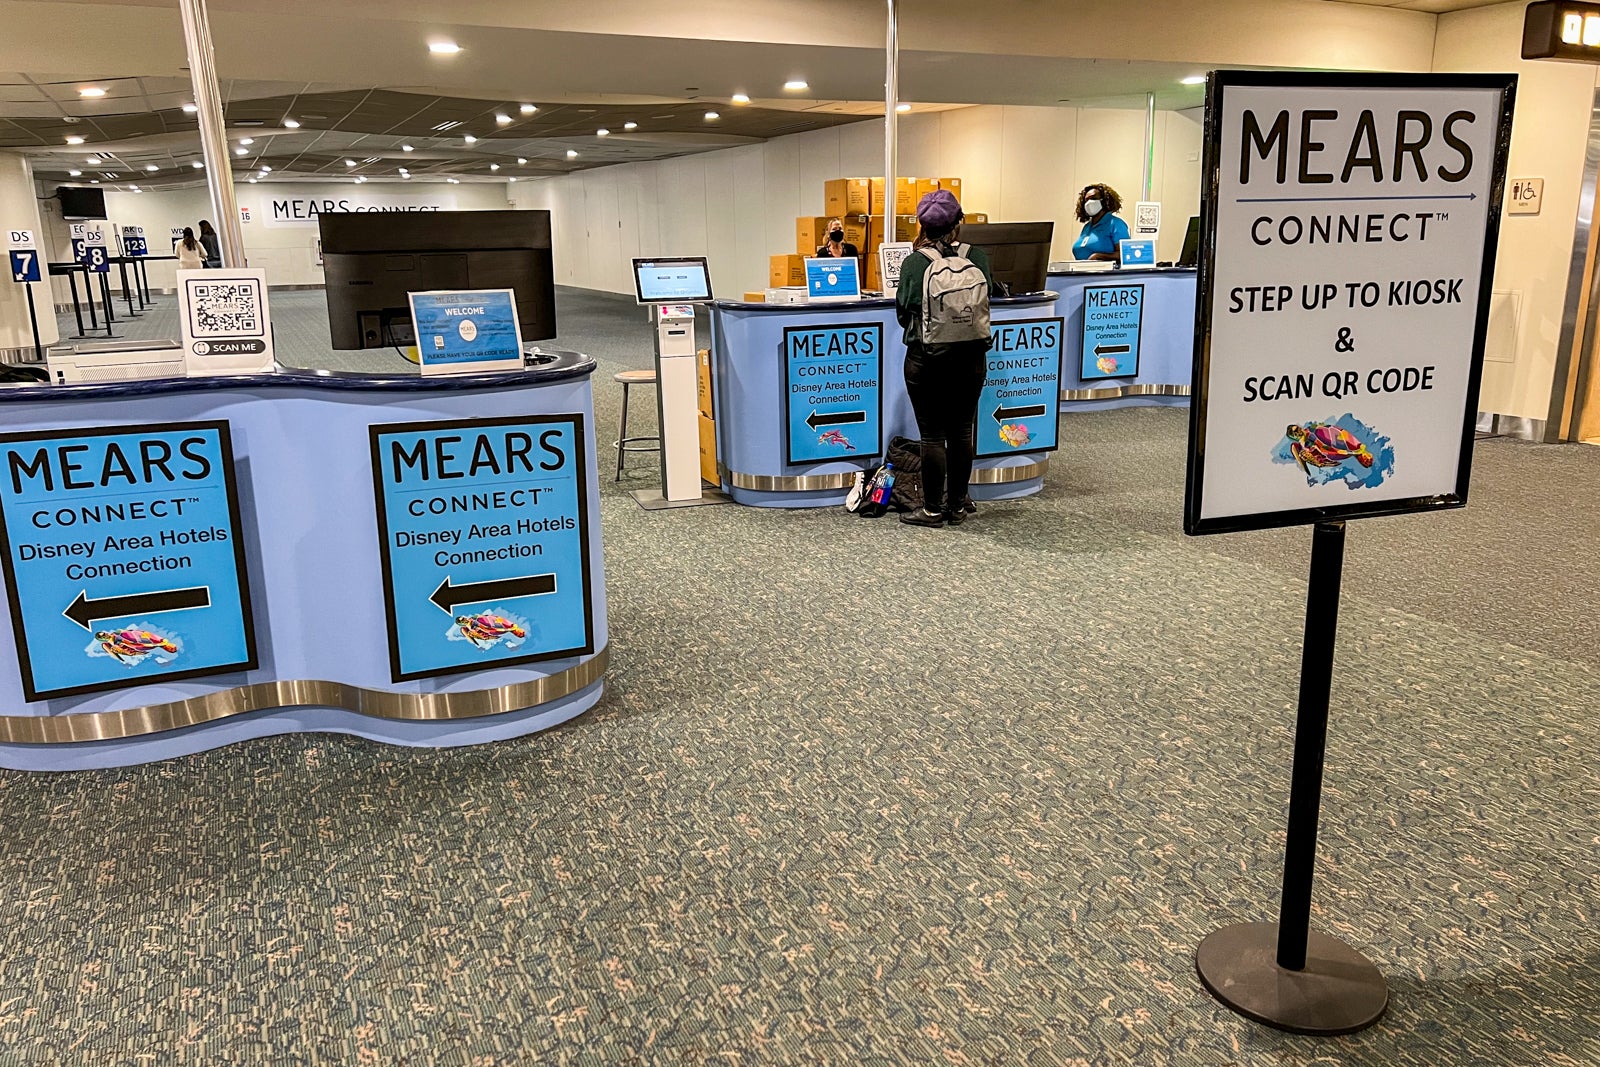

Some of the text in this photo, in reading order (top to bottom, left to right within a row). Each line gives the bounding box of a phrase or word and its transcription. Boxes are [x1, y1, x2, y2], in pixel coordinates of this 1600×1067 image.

[1240, 110, 1475, 184] MEARS
[273, 200, 350, 218] MEARS
[11, 232, 30, 242] DS
[87, 232, 102, 240] DS
[77, 241, 86, 256] 9
[91, 248, 104, 265] 8
[16, 253, 32, 274] 7
[1088, 290, 1138, 307] MEARS
[1229, 279, 1463, 313] STEP UP TO KIOSK
[445, 307, 485, 316] WELCOME
[213, 344, 239, 352] SCAN
[793, 331, 874, 358] MEARS
[1335, 327, 1354, 352] &
[792, 379, 877, 393] Disney Area Hotels
[1011, 375, 1030, 384] Area
[1032, 373, 1056, 382] Hotels
[1243, 366, 1435, 402] SCAN QR CODE
[809, 393, 860, 404] Connection
[996, 387, 1042, 398] Connection
[8, 437, 211, 494] MEARS
[391, 430, 565, 483] MEARS
[396, 516, 575, 548] Disney Area Hotels
[19, 526, 228, 561] Disney Area Hotels
[434, 543, 542, 567] Connection
[66, 554, 191, 580] Connection
